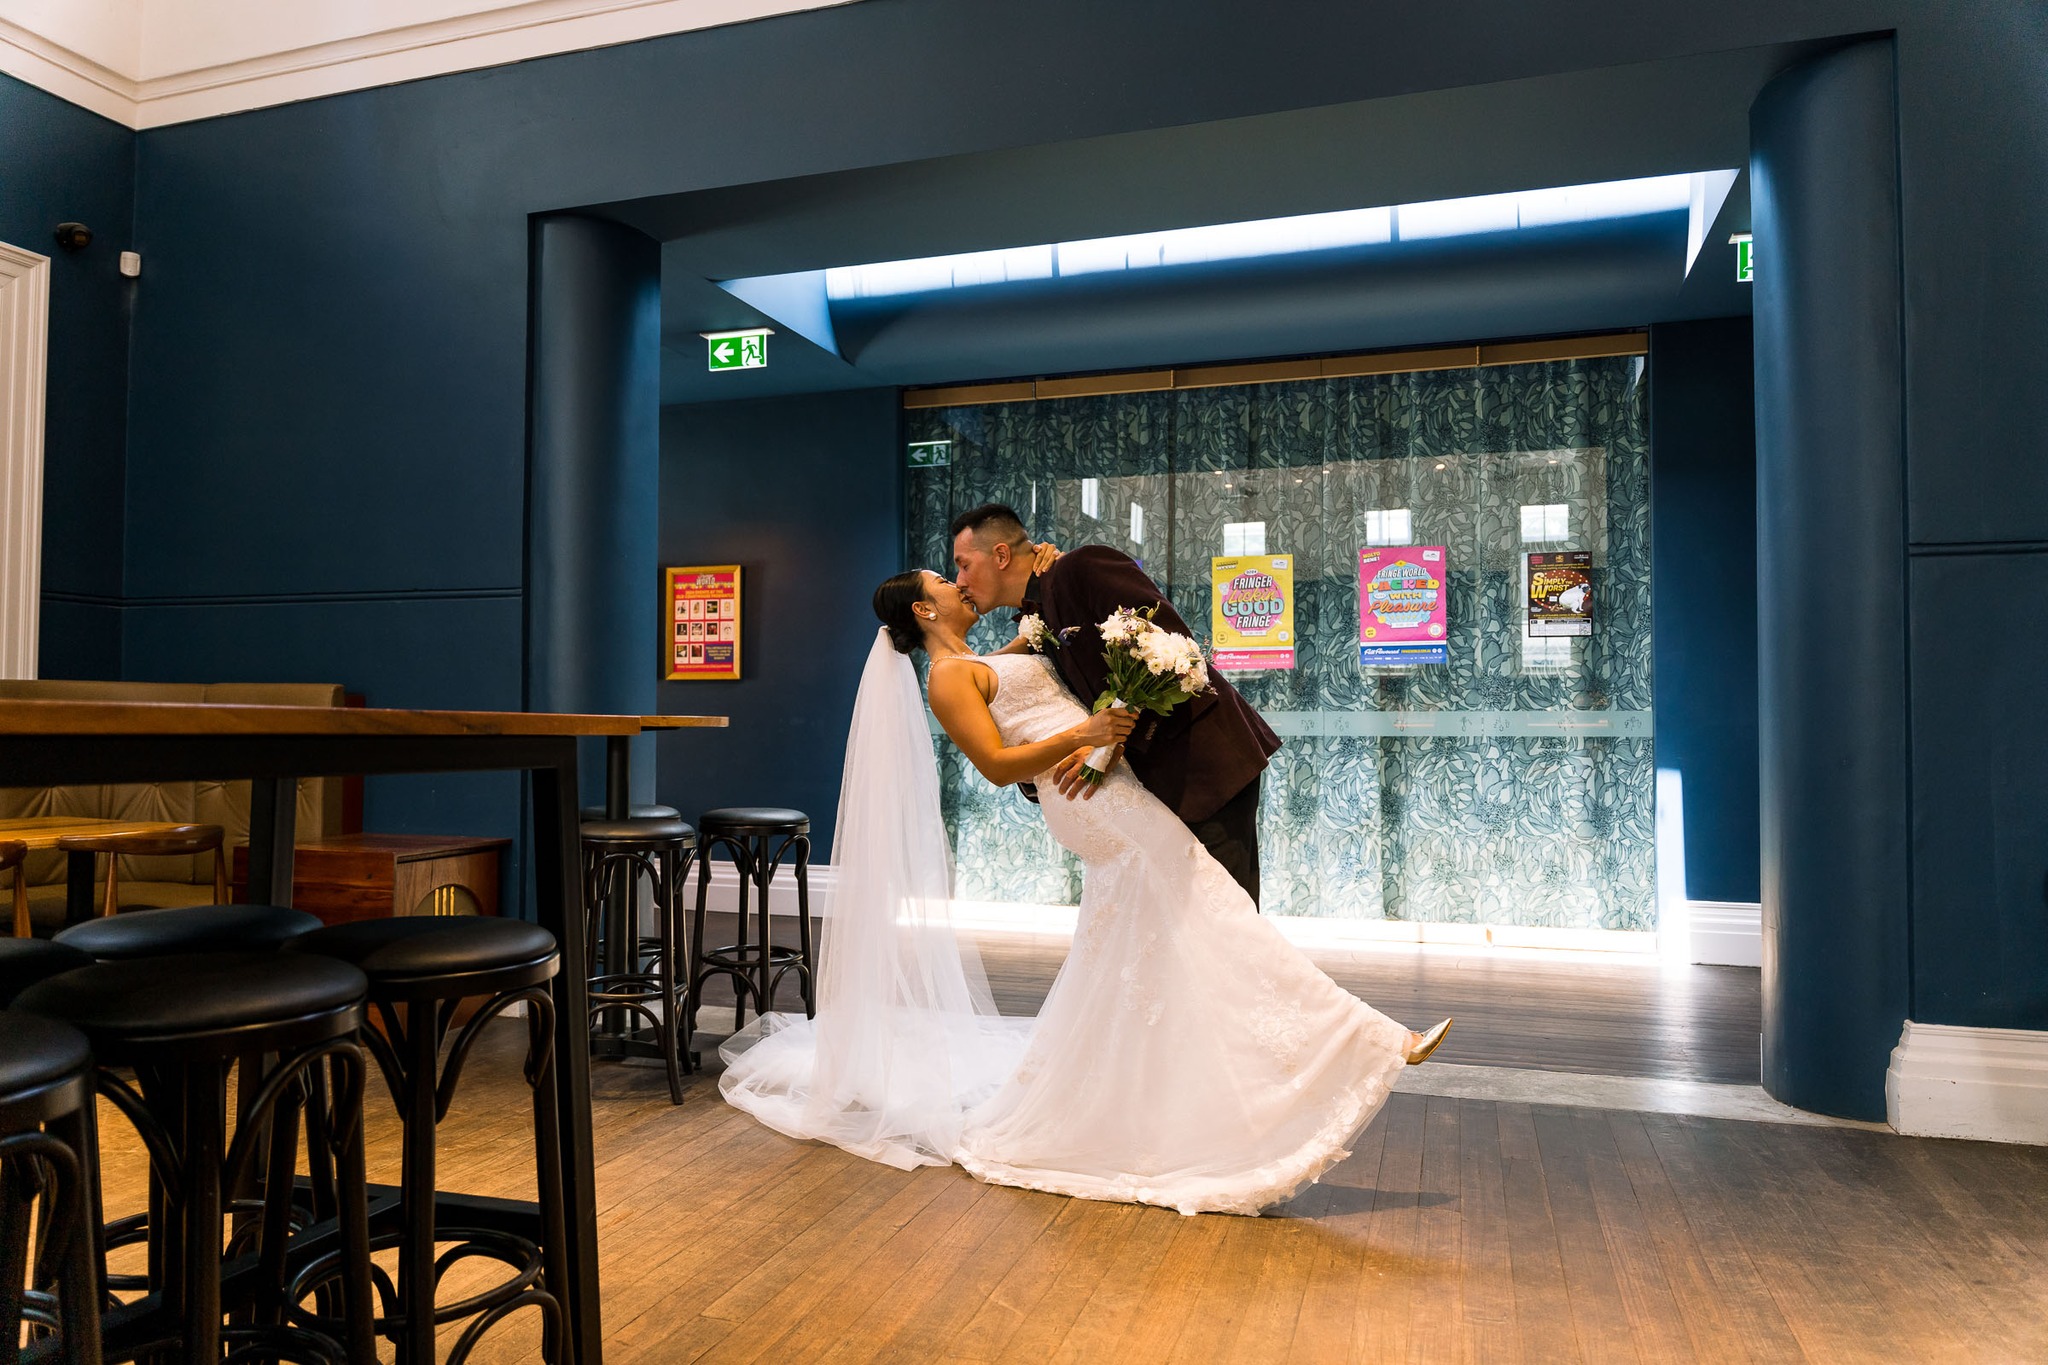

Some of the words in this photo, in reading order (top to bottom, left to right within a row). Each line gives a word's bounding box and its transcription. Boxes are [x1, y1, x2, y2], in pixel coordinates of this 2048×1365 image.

[1376, 569, 1401, 579] FRINGE
[1402, 568, 1427, 577] WORLD
[1233, 576, 1273, 589] FRINGER
[1366, 579, 1440, 593] PACKED
[1389, 592, 1422, 600] WITH
[1531, 585, 1569, 598] WORST
[1222, 598, 1284, 617] GOOD
[1367, 600, 1439, 614] Pleasure
[1236, 615, 1272, 629] FRINGE
